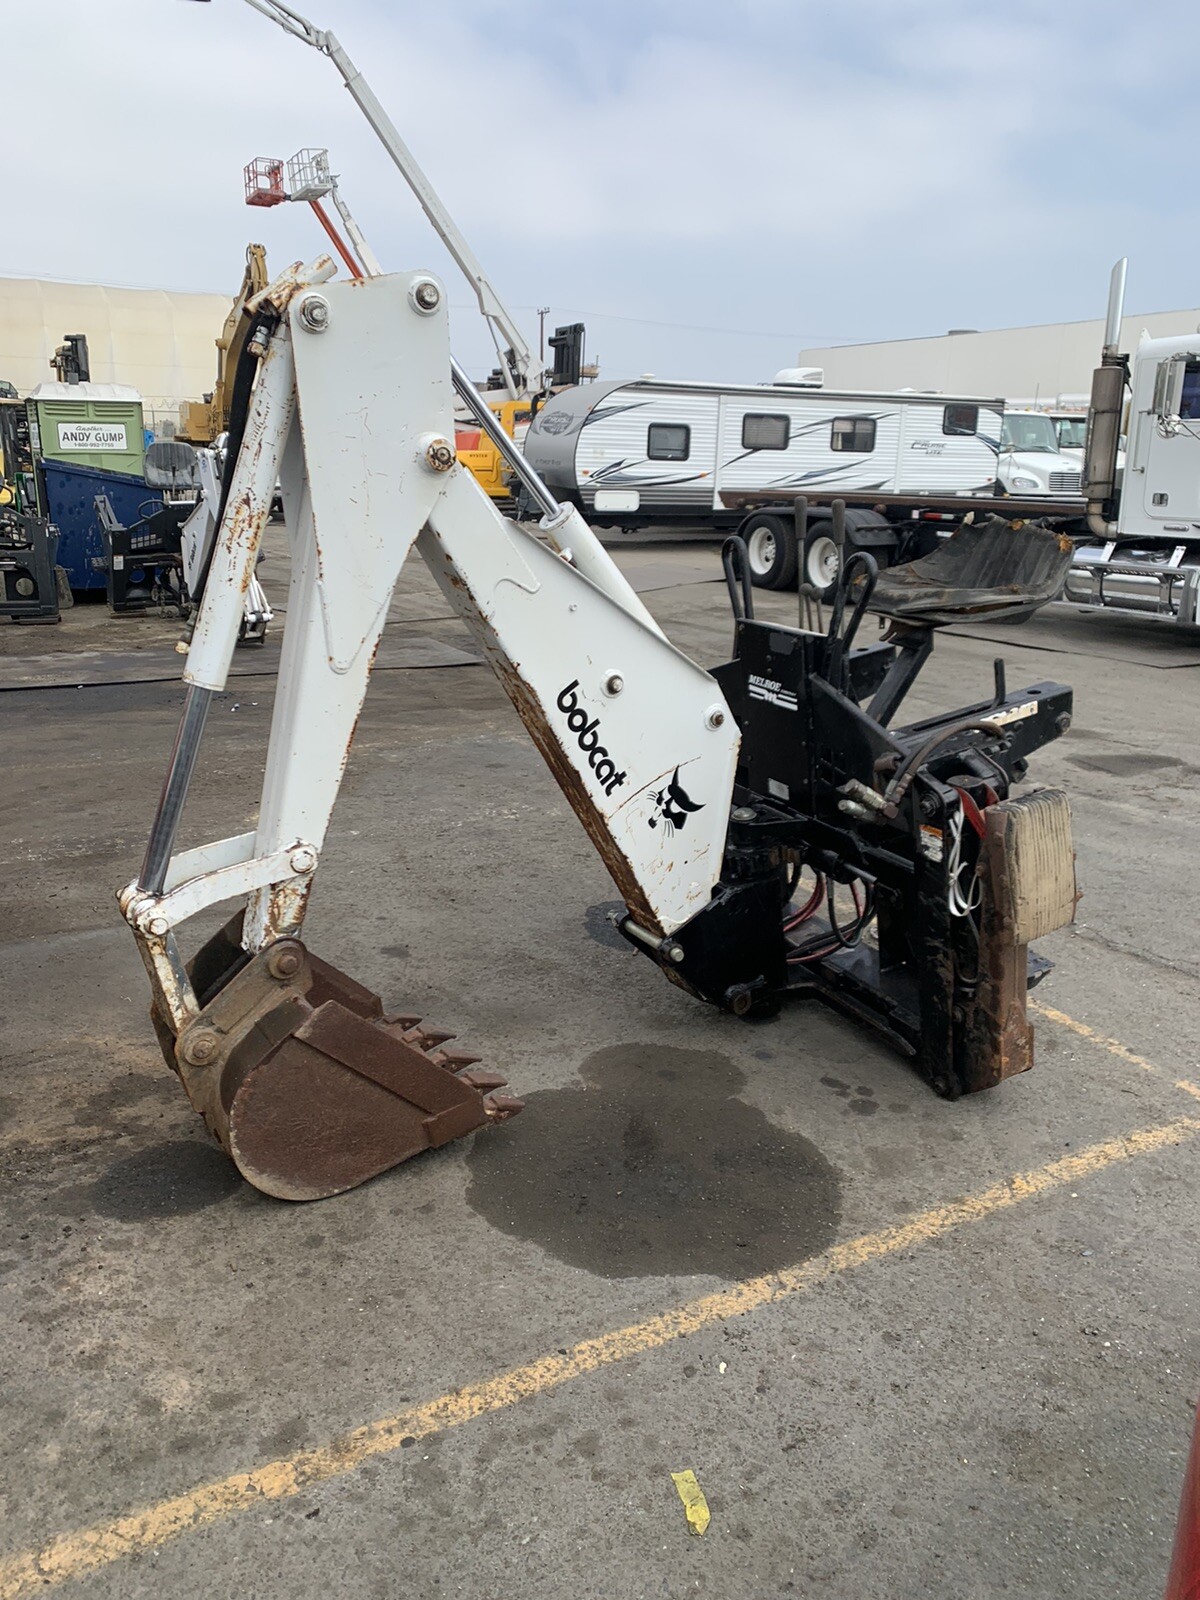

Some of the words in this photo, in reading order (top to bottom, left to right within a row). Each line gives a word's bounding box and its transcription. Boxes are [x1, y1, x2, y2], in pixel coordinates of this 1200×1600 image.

[62, 431, 91, 442] ANDY
[94, 432, 124, 442] GUMP
[748, 674, 782, 692] MELROE
[556, 678, 628, 797] bobcat
